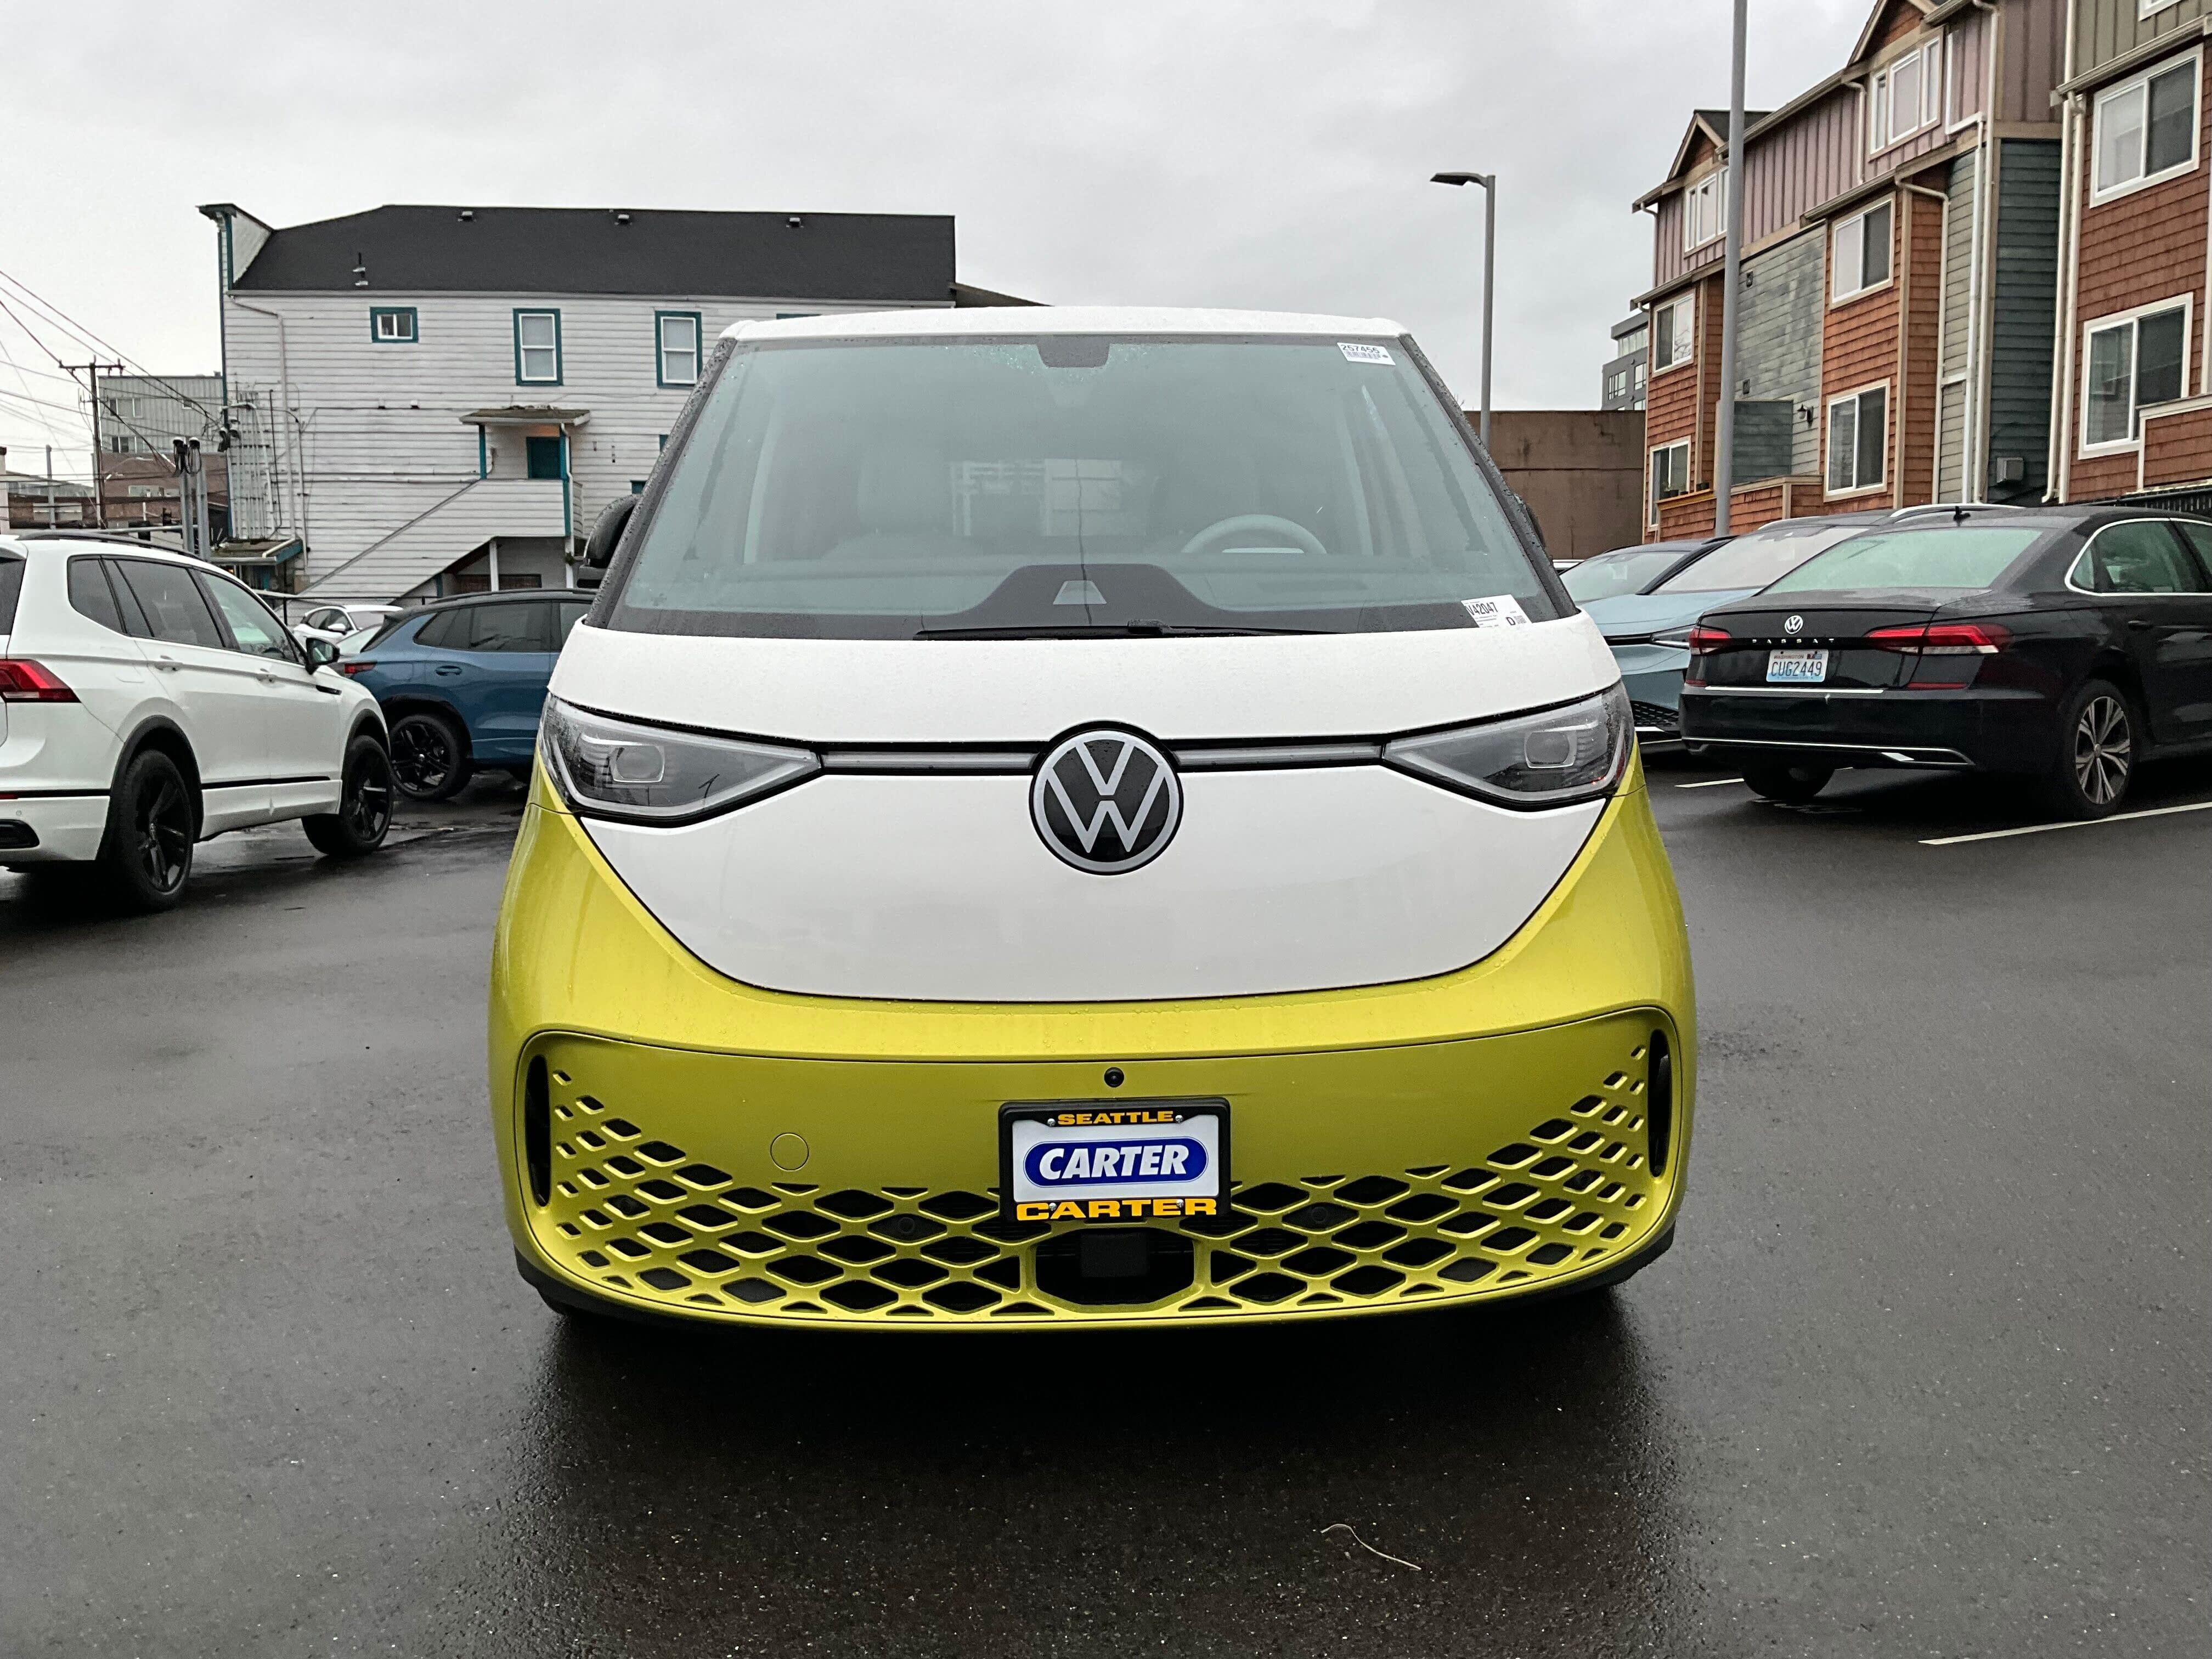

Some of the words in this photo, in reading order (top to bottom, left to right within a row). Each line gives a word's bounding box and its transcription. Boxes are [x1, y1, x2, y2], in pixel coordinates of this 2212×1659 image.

[1465, 602, 1498, 616] V42047
[1506, 617, 1516, 625] D
[1786, 616, 1803, 634] VW
[1771, 661, 1822, 676] CUG2449
[1041, 737, 1172, 856] VW
[1058, 1111, 1173, 1125] SEATTLE
[1039, 1144, 1189, 1180] CARTER
[1016, 1198, 1217, 1221] CARTER
